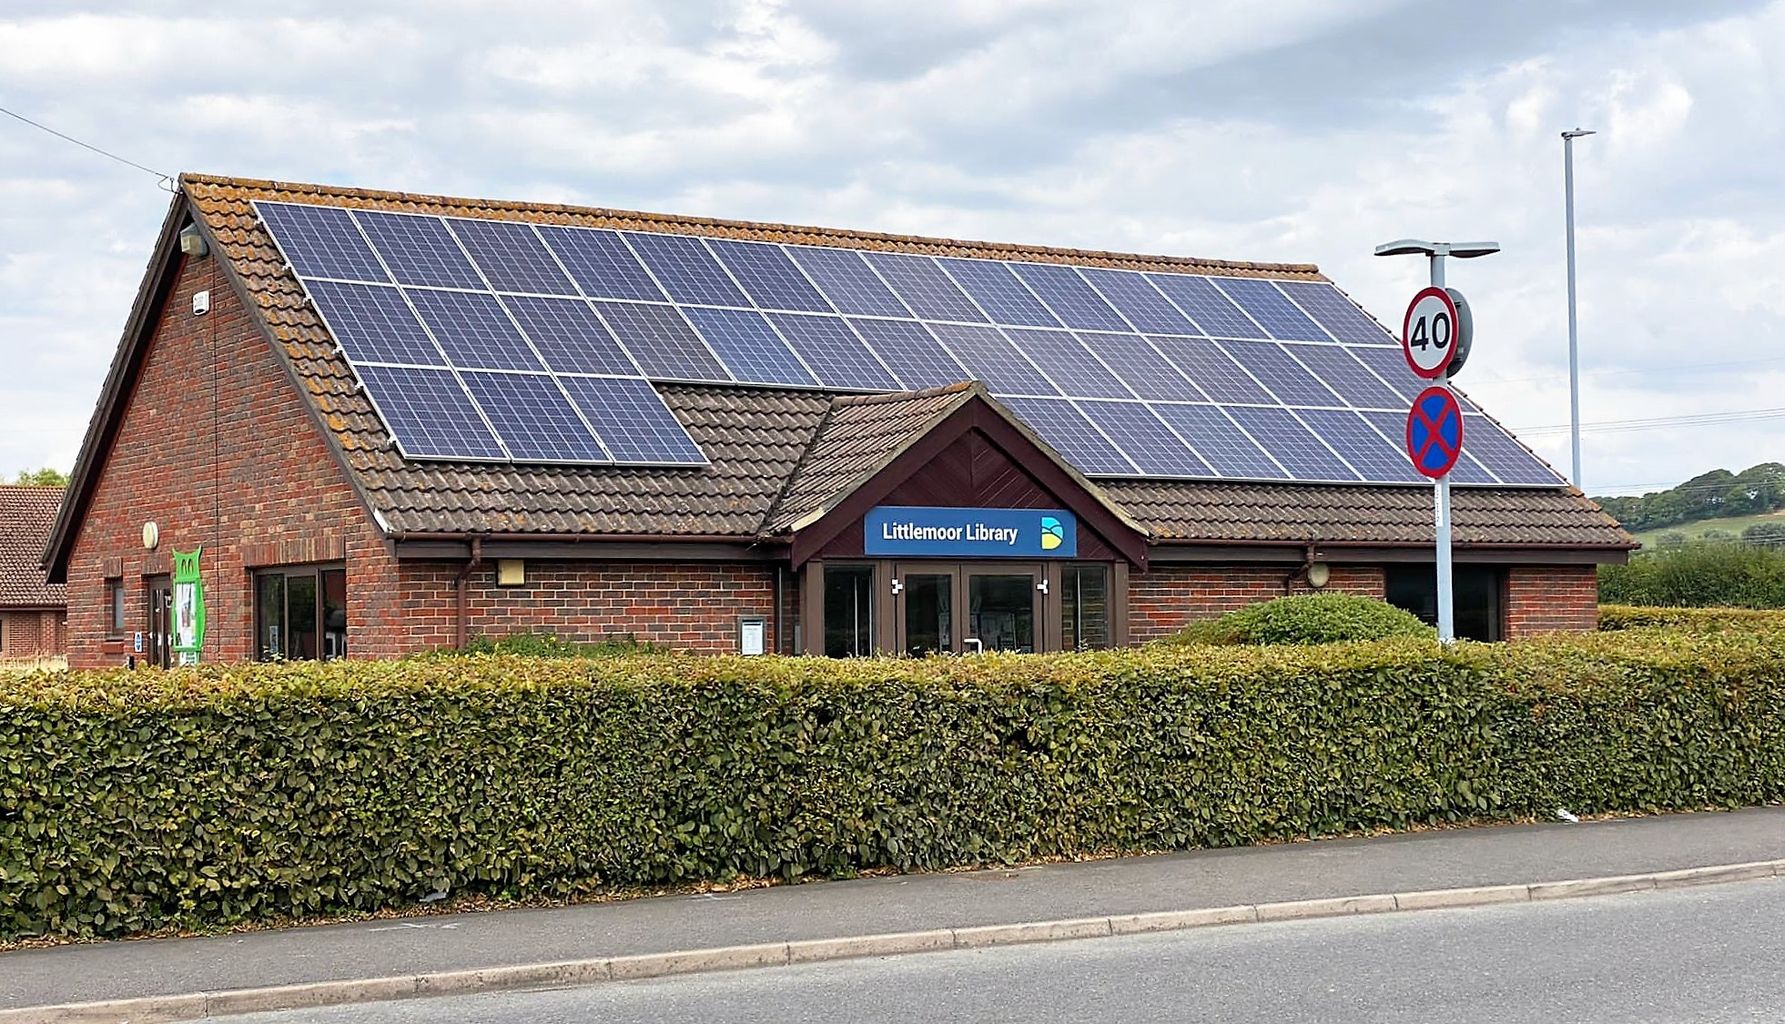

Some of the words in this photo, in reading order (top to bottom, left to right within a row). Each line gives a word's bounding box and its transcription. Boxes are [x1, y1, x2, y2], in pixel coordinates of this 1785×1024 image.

[1411, 312, 1450, 351] 40
[882, 522, 963, 541] Littlemoor
[966, 523, 1019, 546] Library
